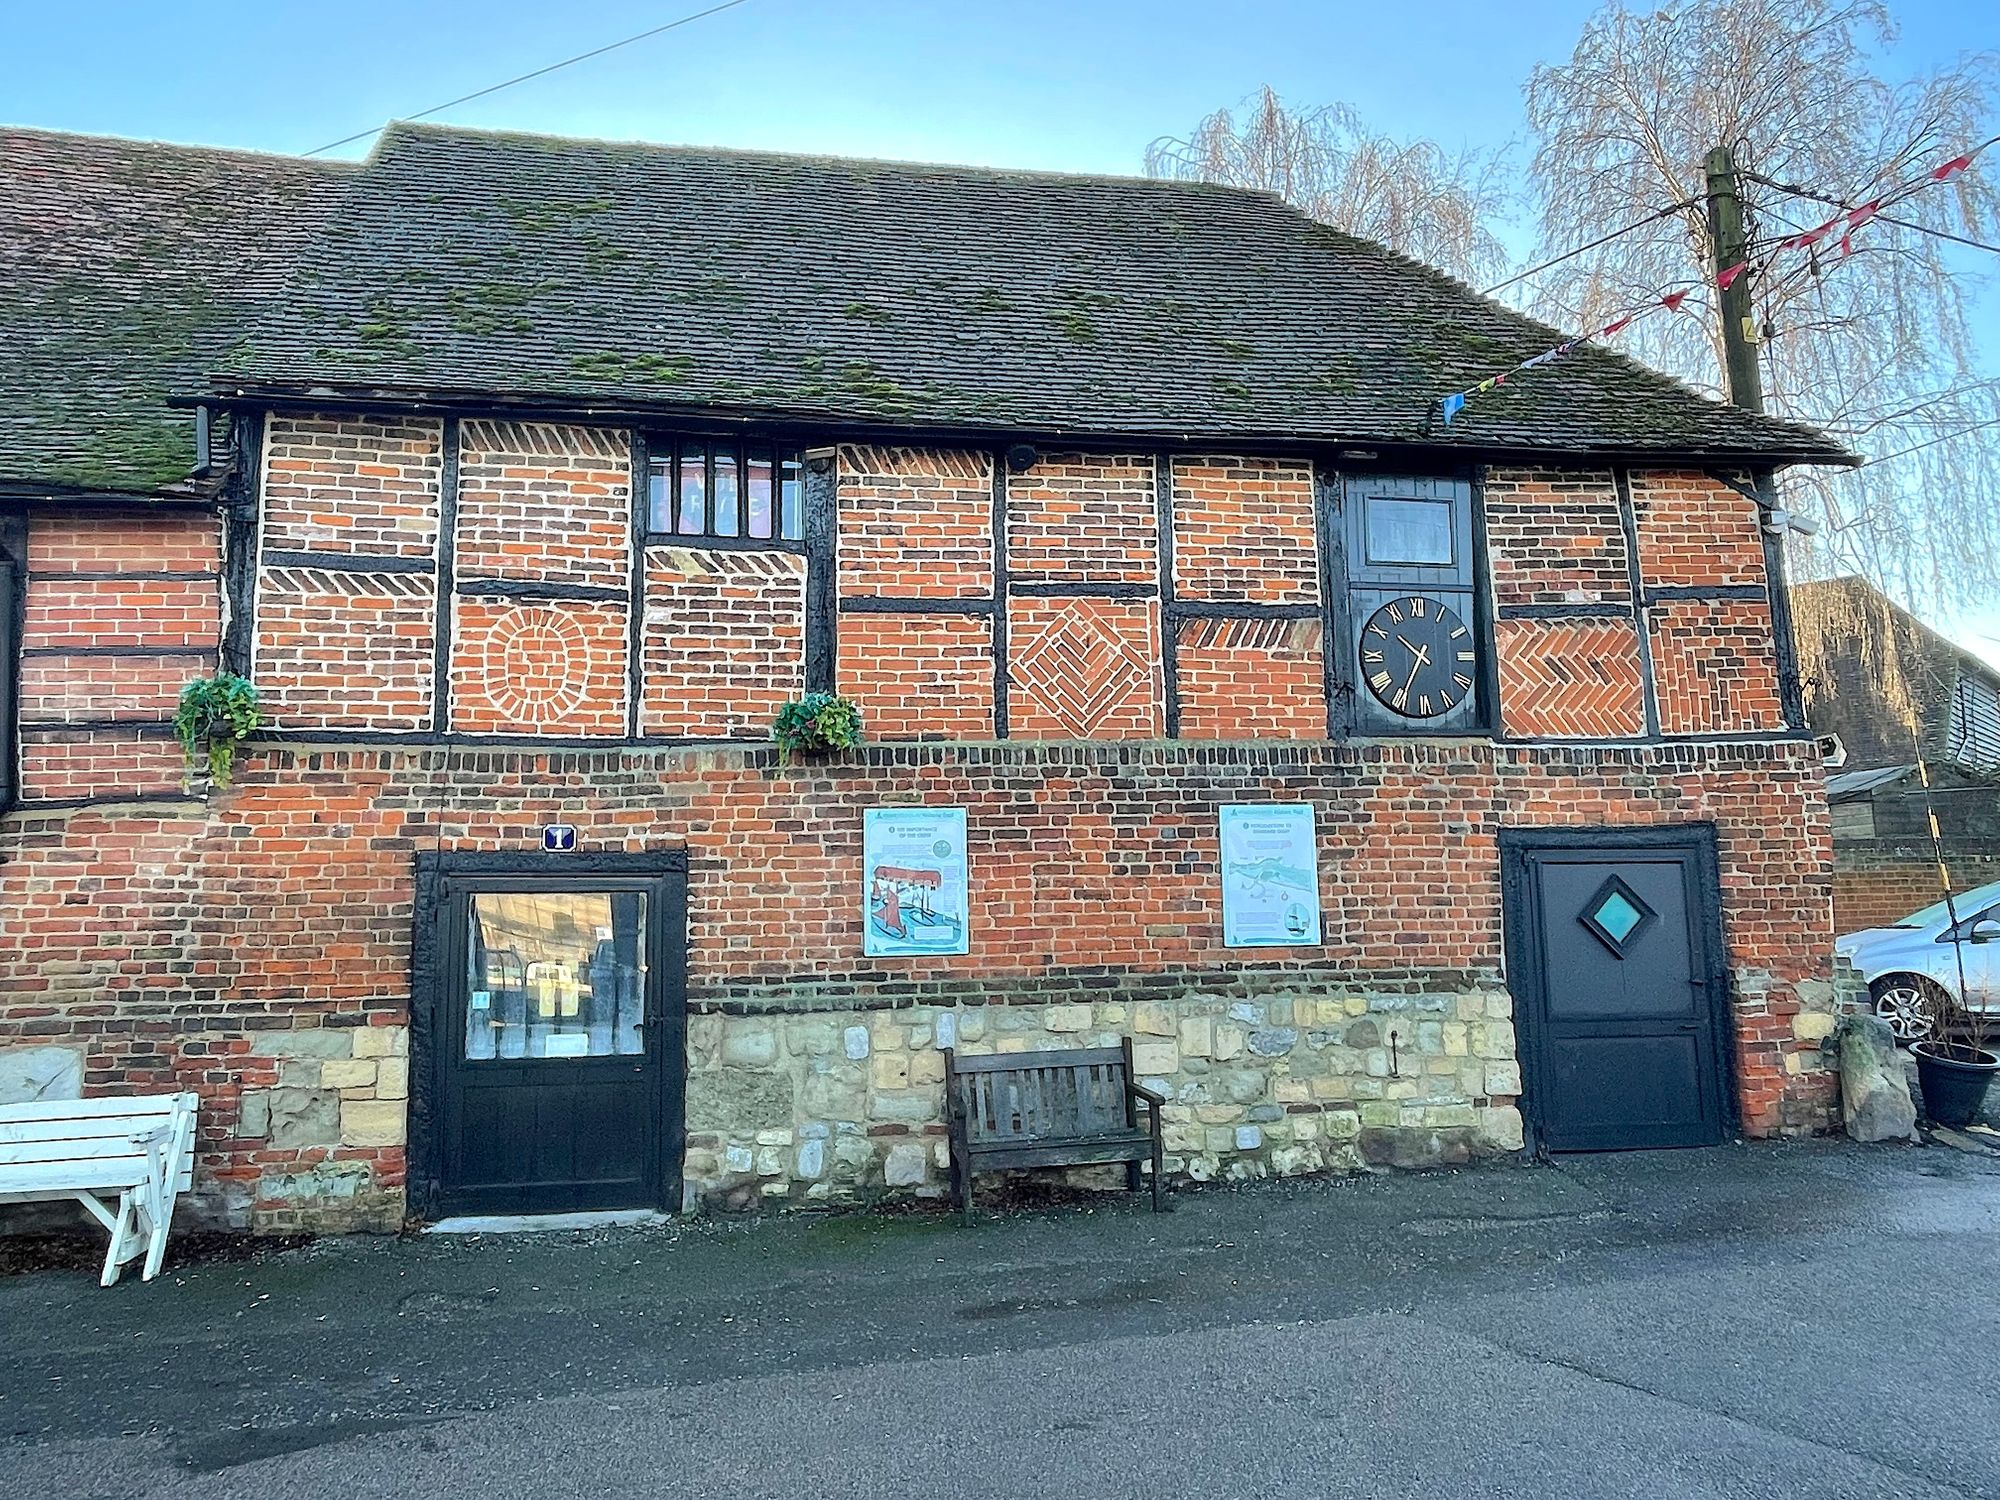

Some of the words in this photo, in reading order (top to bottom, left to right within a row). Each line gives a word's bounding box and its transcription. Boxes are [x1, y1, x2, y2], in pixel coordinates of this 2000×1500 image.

[1385, 603, 1404, 625] XI
[1409, 598, 1425, 618] XII
[1435, 605, 1446, 623] I
[1368, 623, 1389, 640] X
[1450, 626, 1466, 639] II
[1363, 650, 1384, 663] IX
[554, 828, 564, 848] 1
